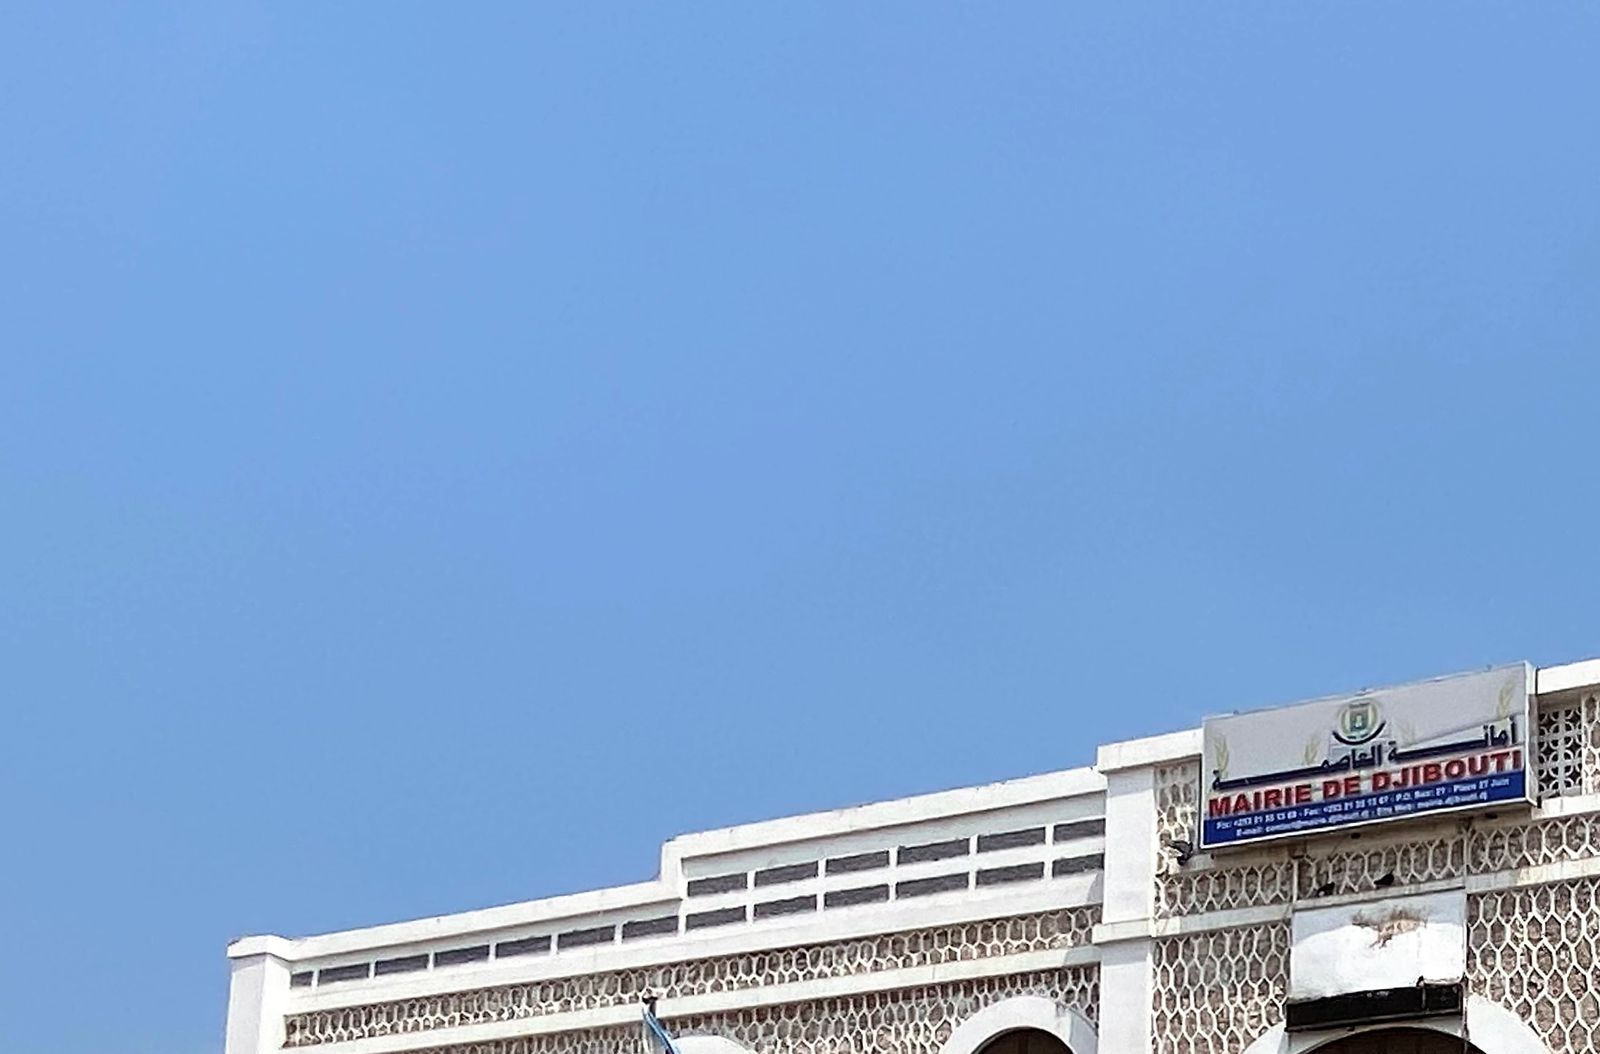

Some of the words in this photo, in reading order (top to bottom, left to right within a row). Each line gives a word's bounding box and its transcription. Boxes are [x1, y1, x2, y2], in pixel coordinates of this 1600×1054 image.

[1208, 784, 1312, 817] MAIRIE
[1322, 776, 1361, 800] DE
[1371, 750, 1522, 792] DJIBOUTI
